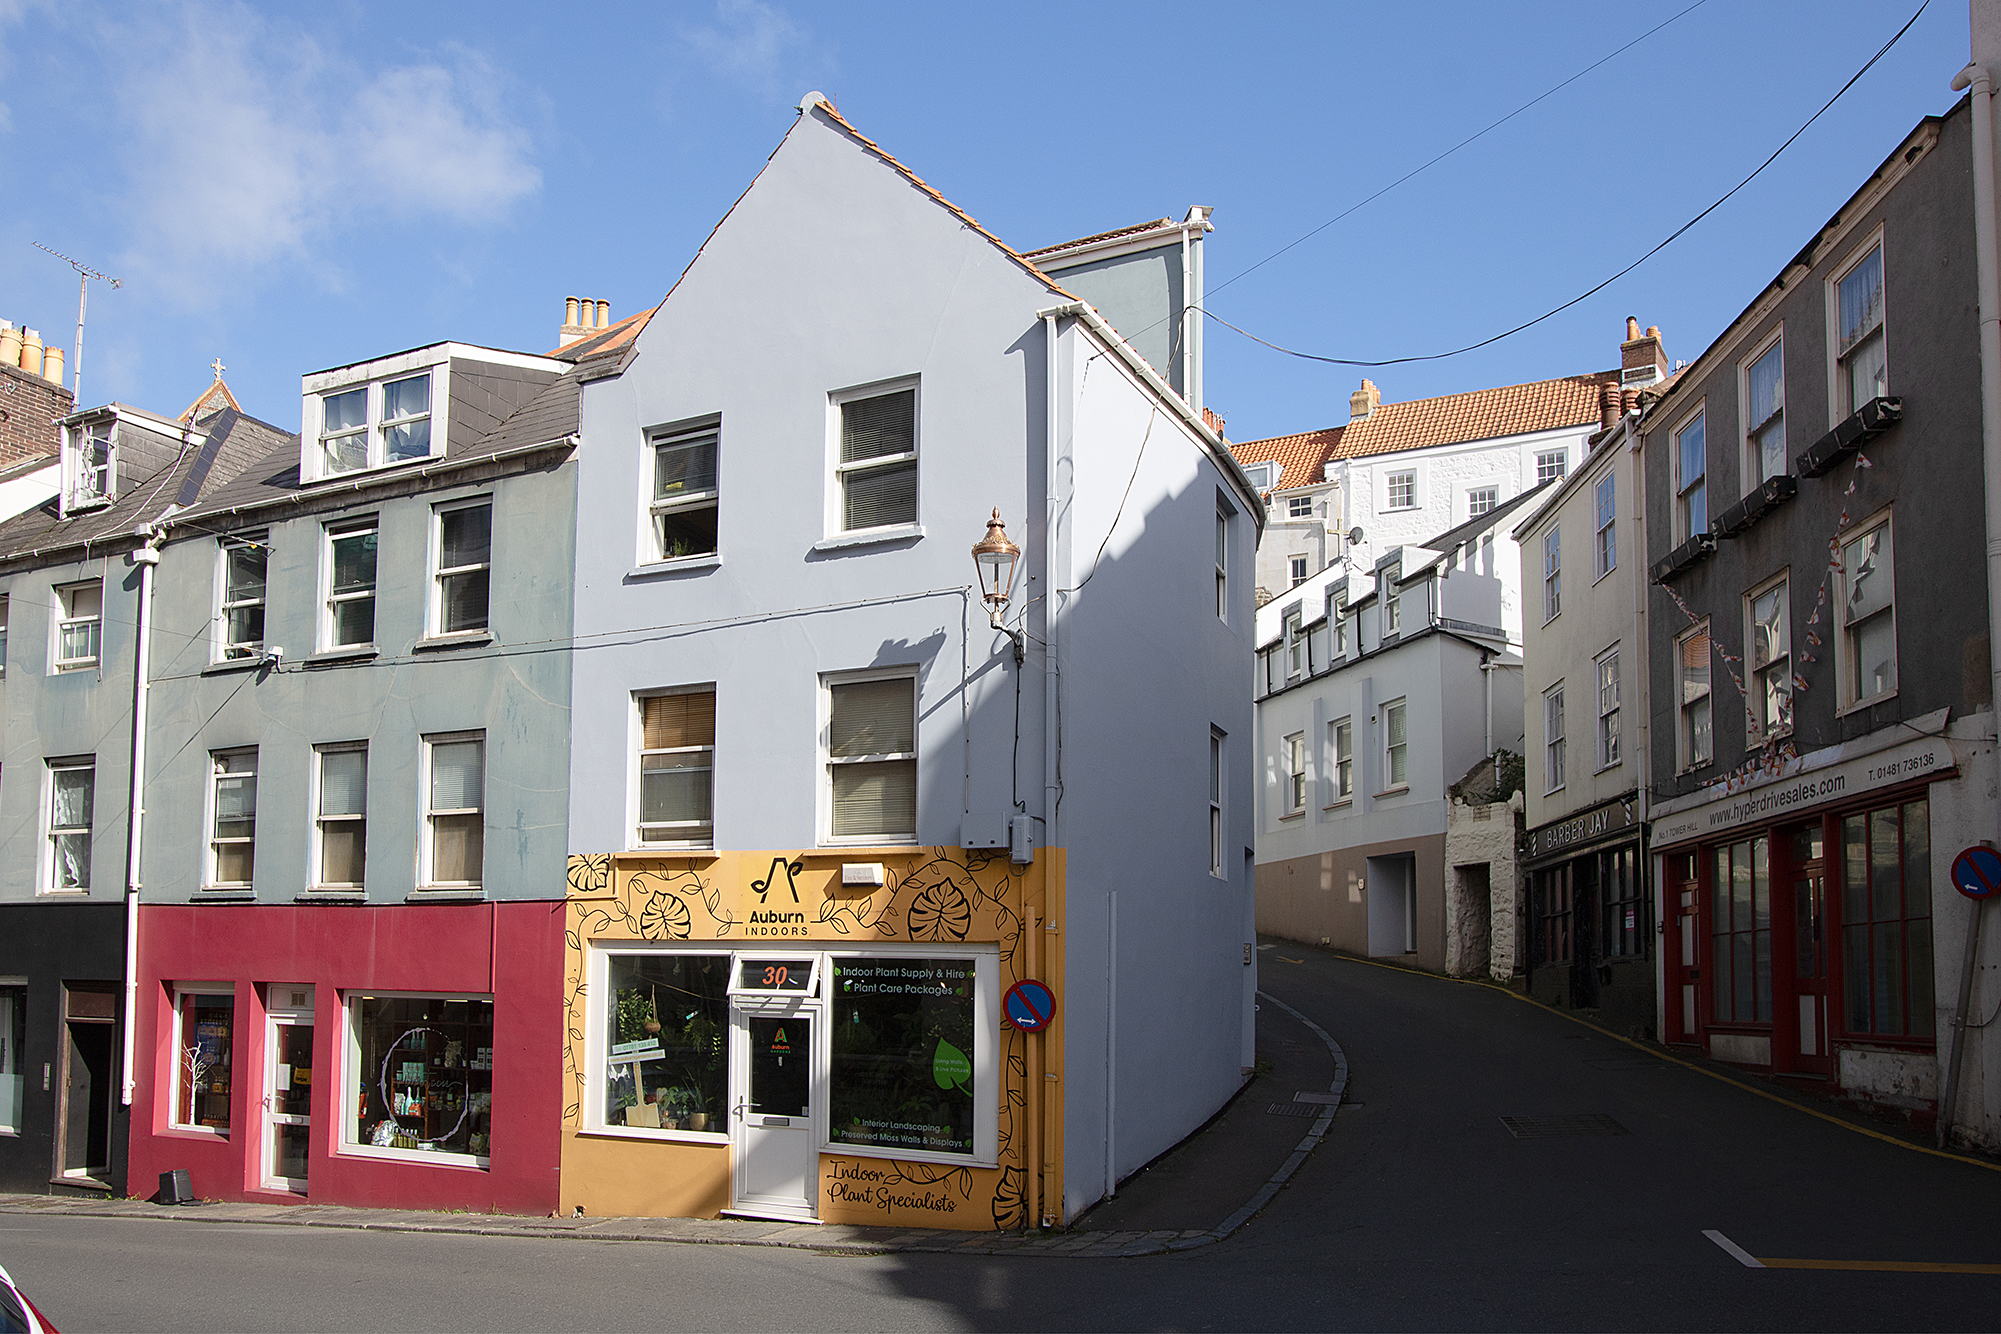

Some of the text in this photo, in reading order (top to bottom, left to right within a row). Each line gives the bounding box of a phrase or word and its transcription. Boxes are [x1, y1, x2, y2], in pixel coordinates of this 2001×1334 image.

[1868, 752, 1935, 782] T. 01481 736136
[1709, 774, 1846, 826] www.hyperdrivesales.com
[1547, 809, 1610, 849] BARBER JAY
[1669, 824, 1687, 837] TOWER
[1687, 821, 1698, 833] HILL
[749, 910, 804, 924] Auburn
[745, 926, 808, 936] INDOORS
[762, 966, 788, 985] 30
[843, 967, 965, 980] Indoor Plant Supply & Hire
[854, 983, 953, 997] Plant Care Packages
[862, 1118, 941, 1134] Interior Landscaping
[841, 1130, 963, 1149] Preserved Moss Walls & Displays
[826, 1159, 885, 1182] Indoor
[827, 1181, 957, 1215] Plant Specialists
